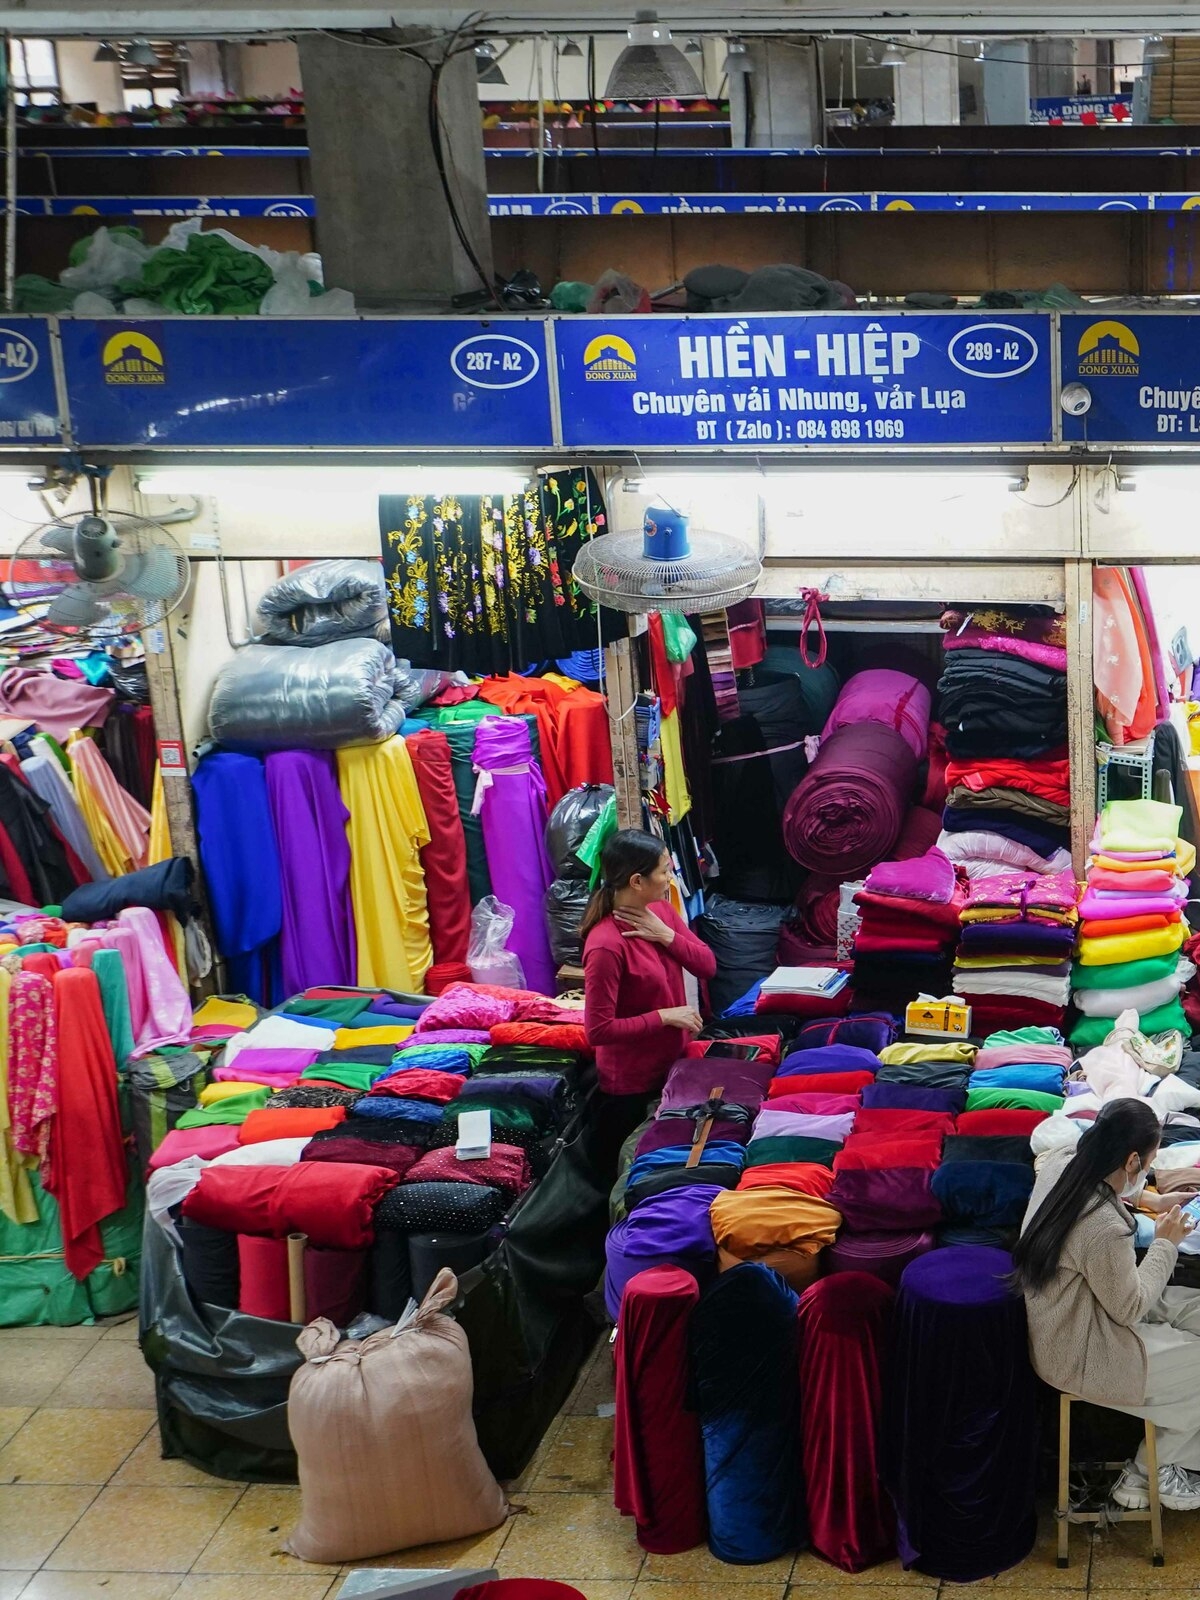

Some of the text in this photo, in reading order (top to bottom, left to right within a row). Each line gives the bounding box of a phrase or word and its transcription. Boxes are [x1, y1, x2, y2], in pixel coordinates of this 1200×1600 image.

[678, 321, 787, 379] HIỀN
[816, 322, 921, 384] HIỆP
[106, 374, 165, 383] DONG XUAN
[585, 372, 637, 380] DONG XUAN
[1078, 365, 1140, 375] DONG XUAN
[632, 388, 726, 416] Chuyên
[732, 385, 771, 412] vải
[779, 387, 868, 413] Nhung,
[920, 387, 967, 414] Lụa
[696, 420, 717, 440] ĐT
[797, 419, 827, 440] 084
[831, 419, 861, 439] 898
[865, 419, 905, 439] 1969
[1157, 415, 1183, 433] ĐT:
